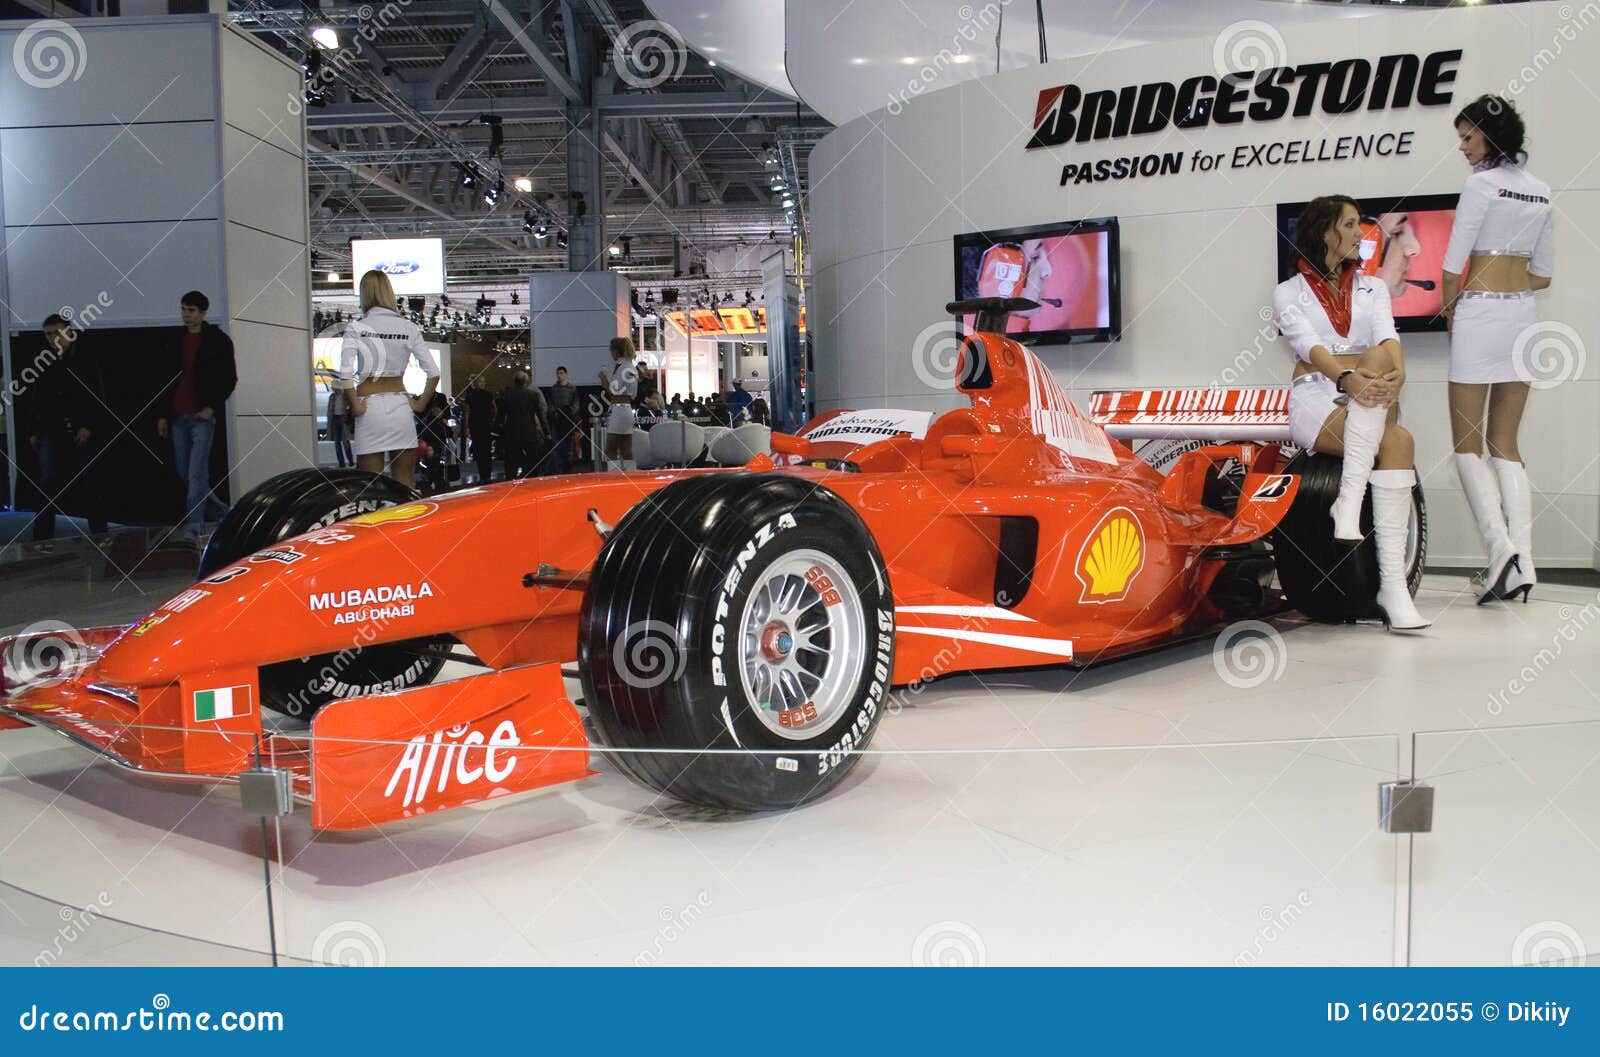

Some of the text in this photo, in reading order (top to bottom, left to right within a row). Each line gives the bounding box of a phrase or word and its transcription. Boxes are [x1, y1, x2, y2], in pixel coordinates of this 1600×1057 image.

[1025, 49, 1463, 150] BRIDGESTONE
[1060, 131, 1415, 186] PASSION for EXCELLENCE
[381, 263, 415, 274] Ford
[309, 582, 433, 611] MUBADALA
[711, 511, 798, 687] POTENZA
[804, 565, 842, 607] BBS
[333, 604, 414, 625] ABU DHABI
[778, 700, 817, 728] BBS
[818, 607, 893, 776] BRIDGESTONE
[383, 719, 521, 807] Alice
